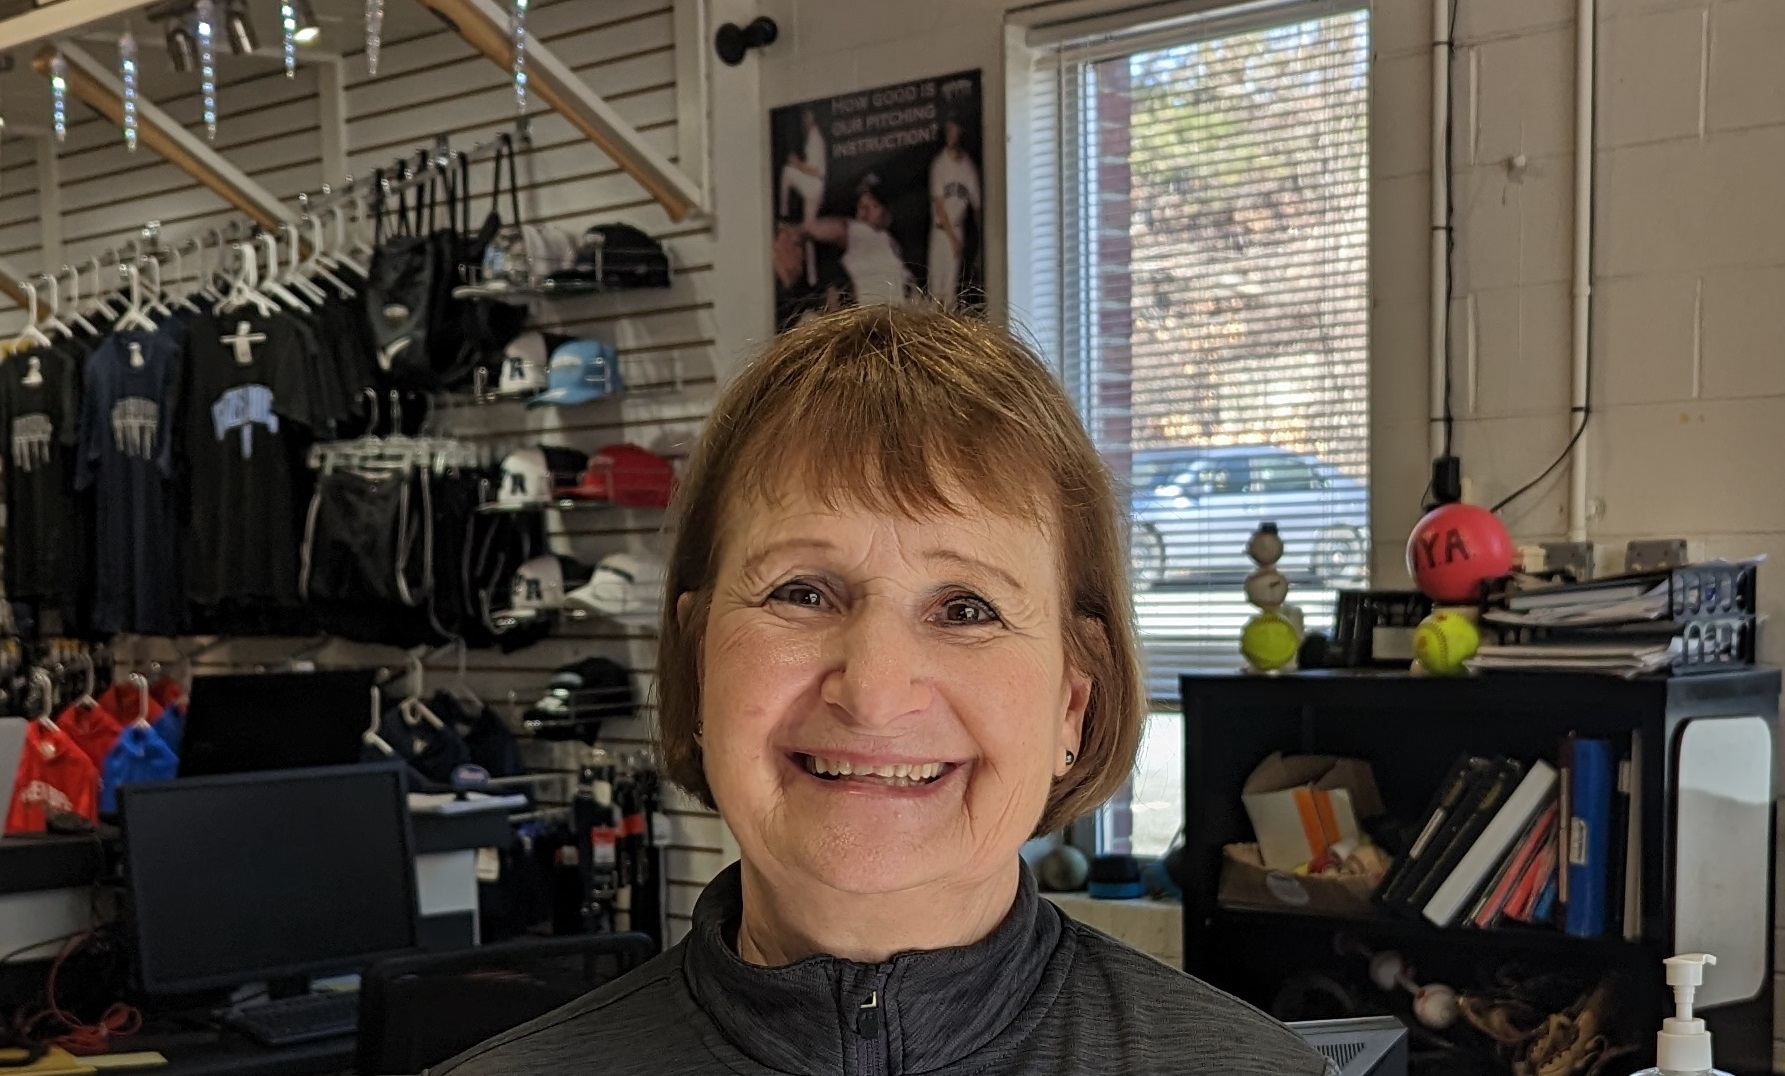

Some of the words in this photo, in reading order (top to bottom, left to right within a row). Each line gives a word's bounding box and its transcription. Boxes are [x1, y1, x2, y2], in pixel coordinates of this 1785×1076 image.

[831, 96, 868, 115] HOW
[872, 85, 916, 107] GOOD
[920, 81, 936, 99] IS
[831, 117, 863, 137] OUR
[866, 102, 936, 130] PITCHING
[832, 120, 939, 158] INSTRUCTION?
